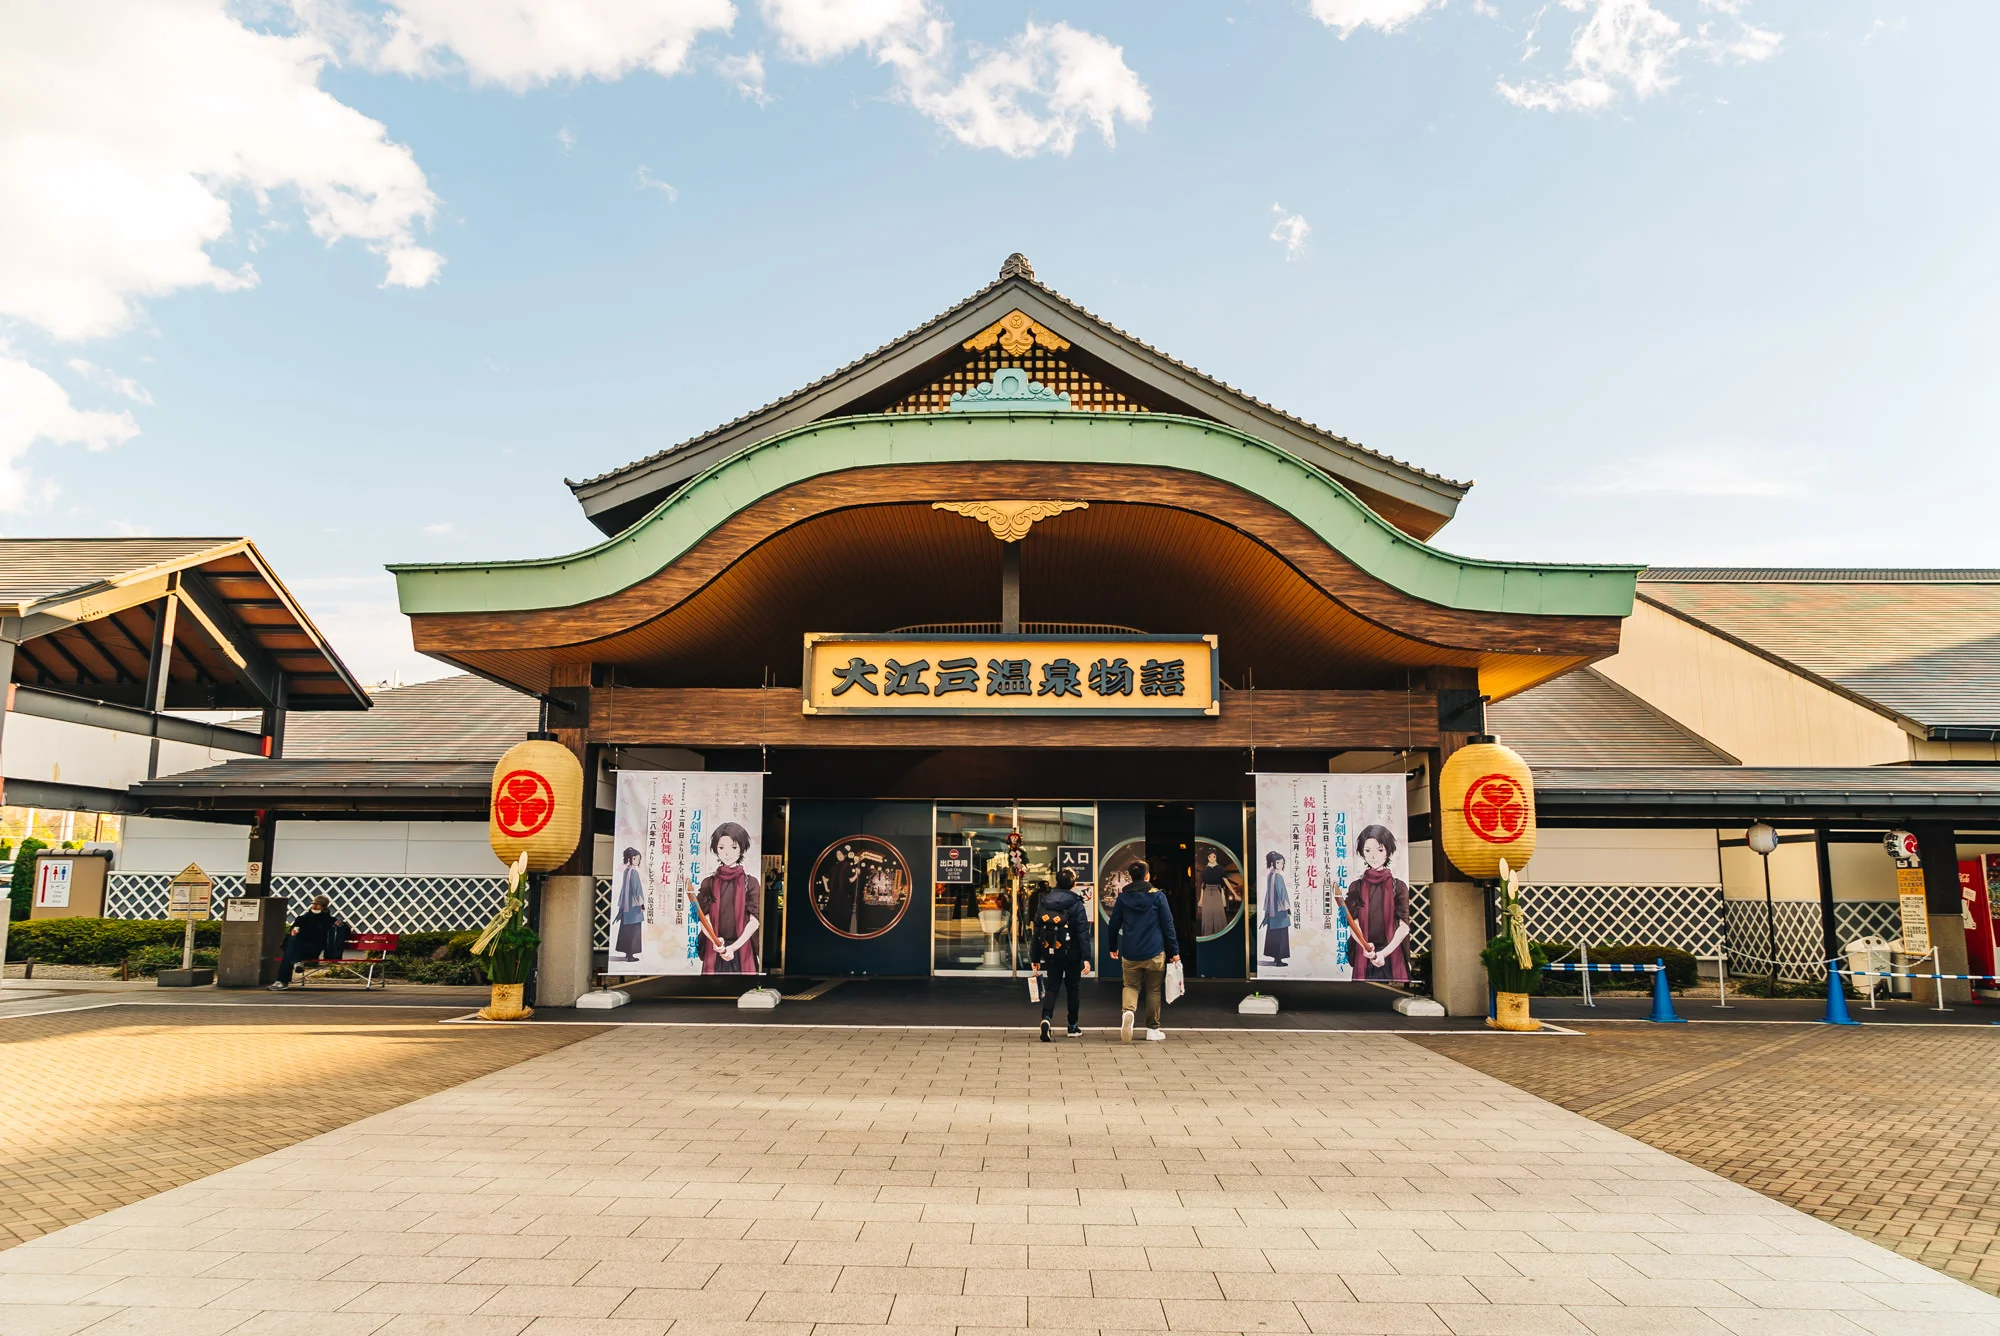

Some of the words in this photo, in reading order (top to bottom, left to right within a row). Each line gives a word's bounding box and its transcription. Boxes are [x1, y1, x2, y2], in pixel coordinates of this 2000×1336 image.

[831, 656, 1185, 698] 大江戸温泉物語
[939, 859, 968, 867] 出口専用
[1062, 851, 1089, 865] 入口
